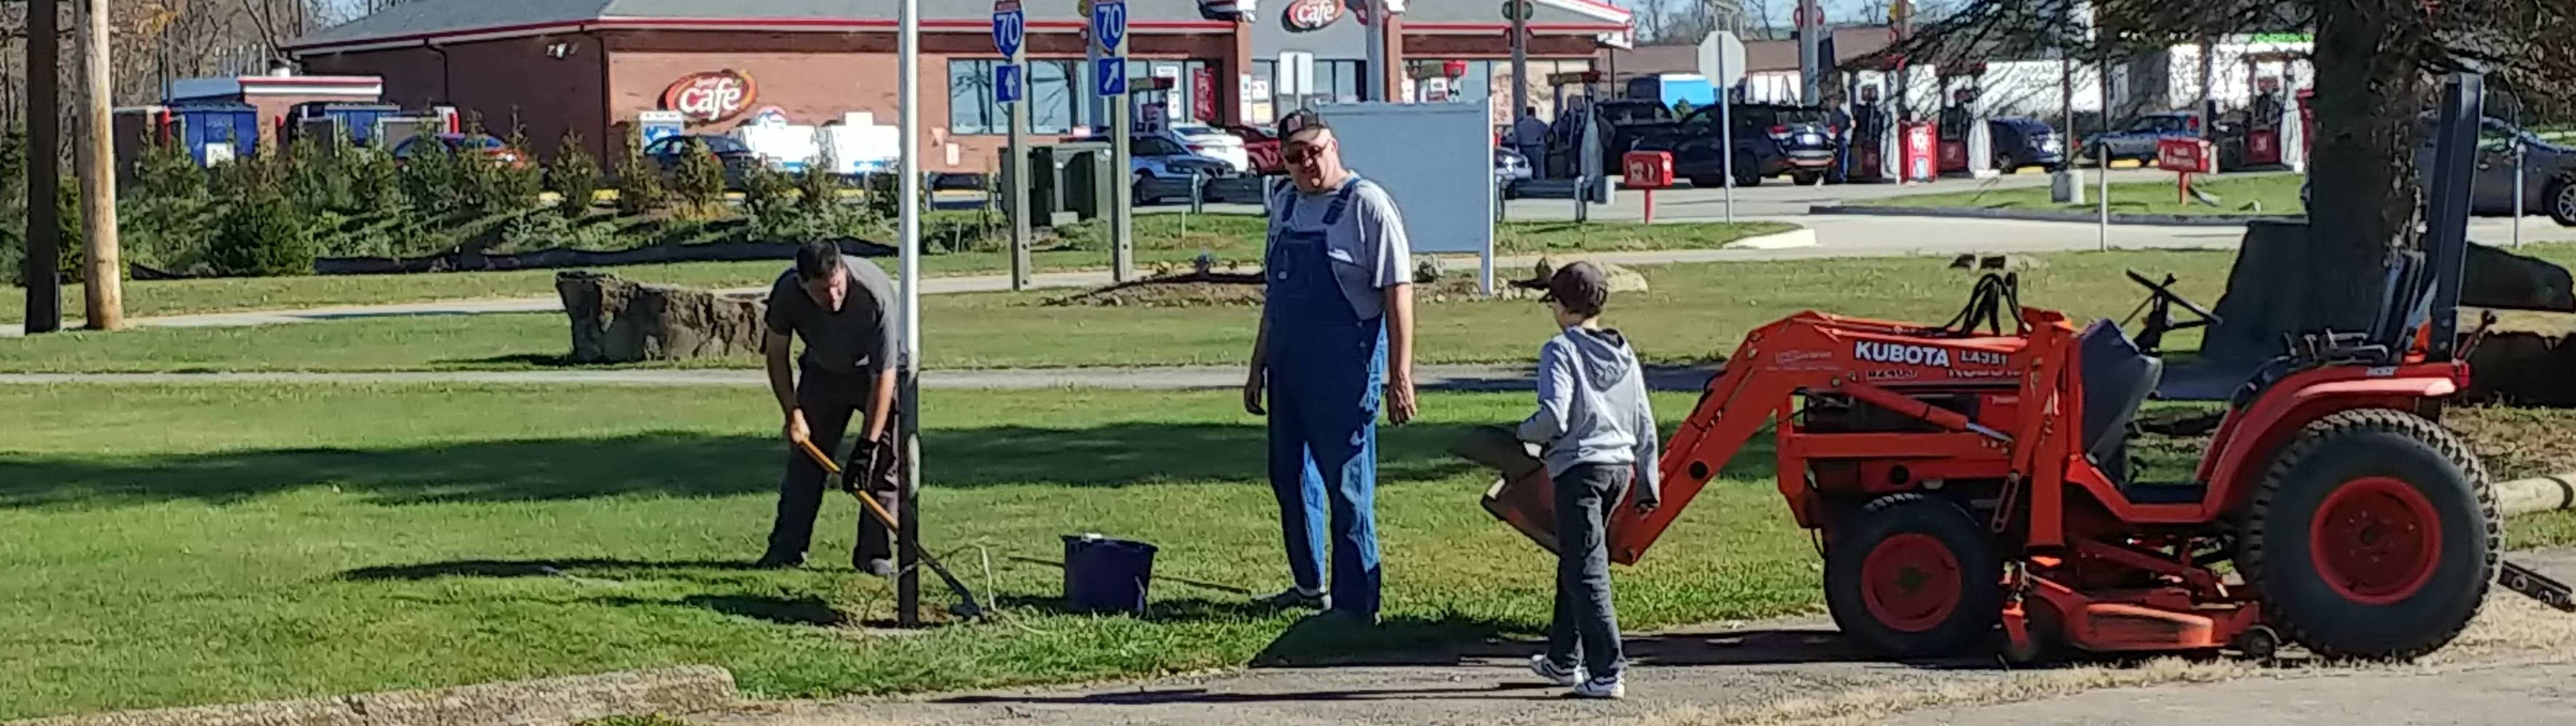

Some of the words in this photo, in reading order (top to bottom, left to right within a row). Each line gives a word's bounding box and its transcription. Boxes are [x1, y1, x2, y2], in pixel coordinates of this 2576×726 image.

[996, 13, 1021, 46] 70
[1098, 5, 1123, 39] 70
[1855, 341, 1950, 367] KUBOTA
